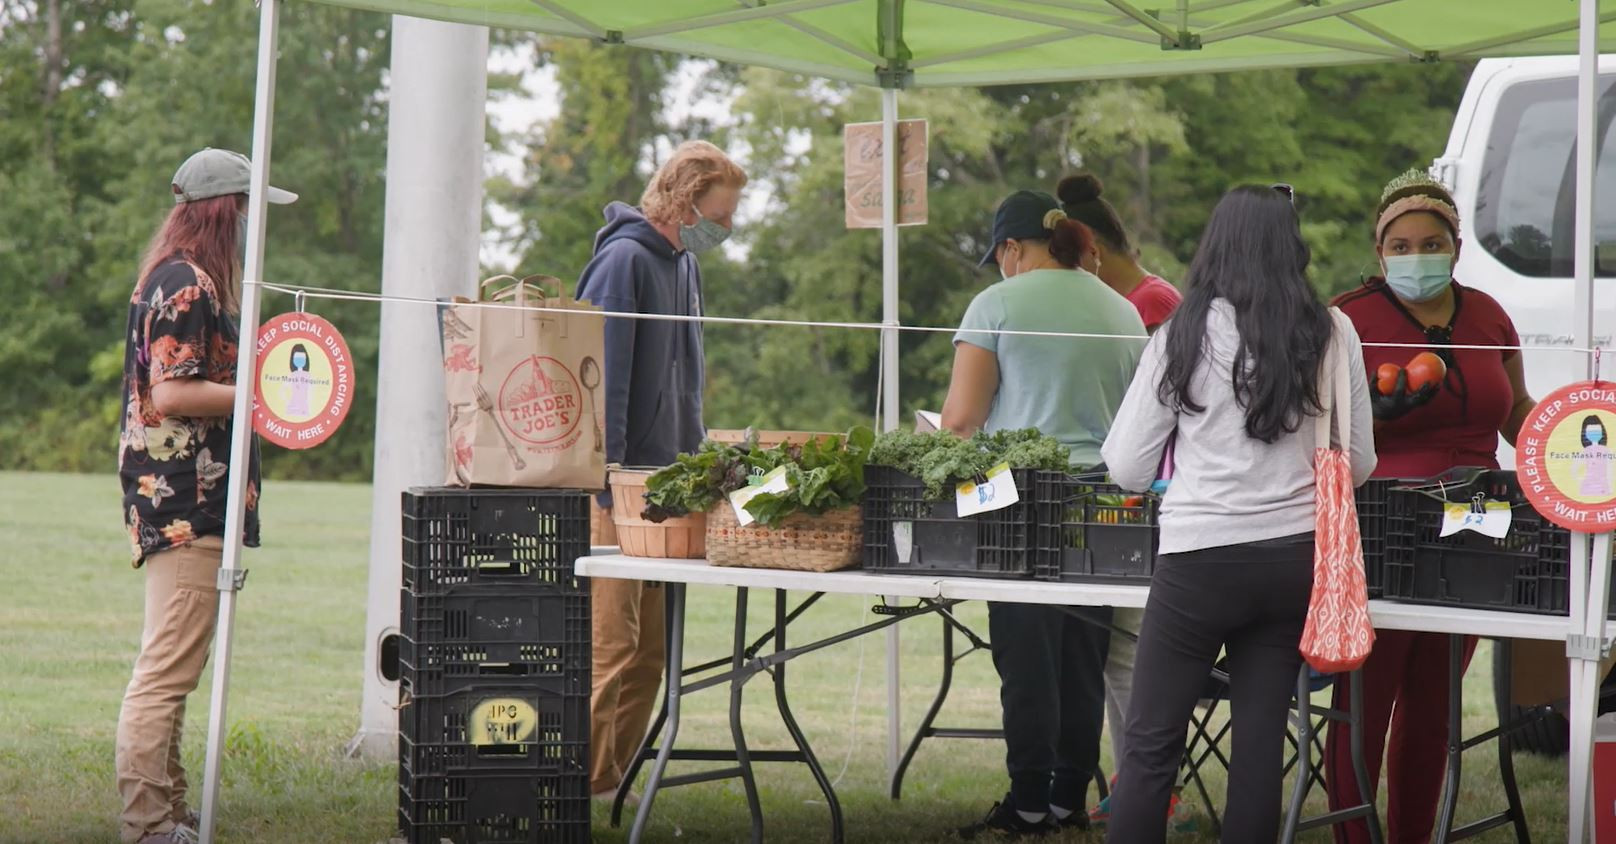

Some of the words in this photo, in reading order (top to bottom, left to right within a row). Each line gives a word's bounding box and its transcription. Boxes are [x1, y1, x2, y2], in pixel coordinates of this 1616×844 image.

[282, 320, 322, 338] SOCIAL
[325, 336, 347, 416] DISTANCING
[510, 393, 576, 421] TRADER
[1533, 399, 1562, 431] KEEP
[266, 419, 292, 439] WAIT
[297, 424, 325, 440] HERE
[523, 411, 570, 434] JOE'S
[1525, 437, 1545, 493] PLEASE
[1550, 451, 1570, 459] Face
[1572, 451, 1594, 459] Mask
[1554, 501, 1589, 522] WAIT
[1597, 507, 1616, 523] HE
